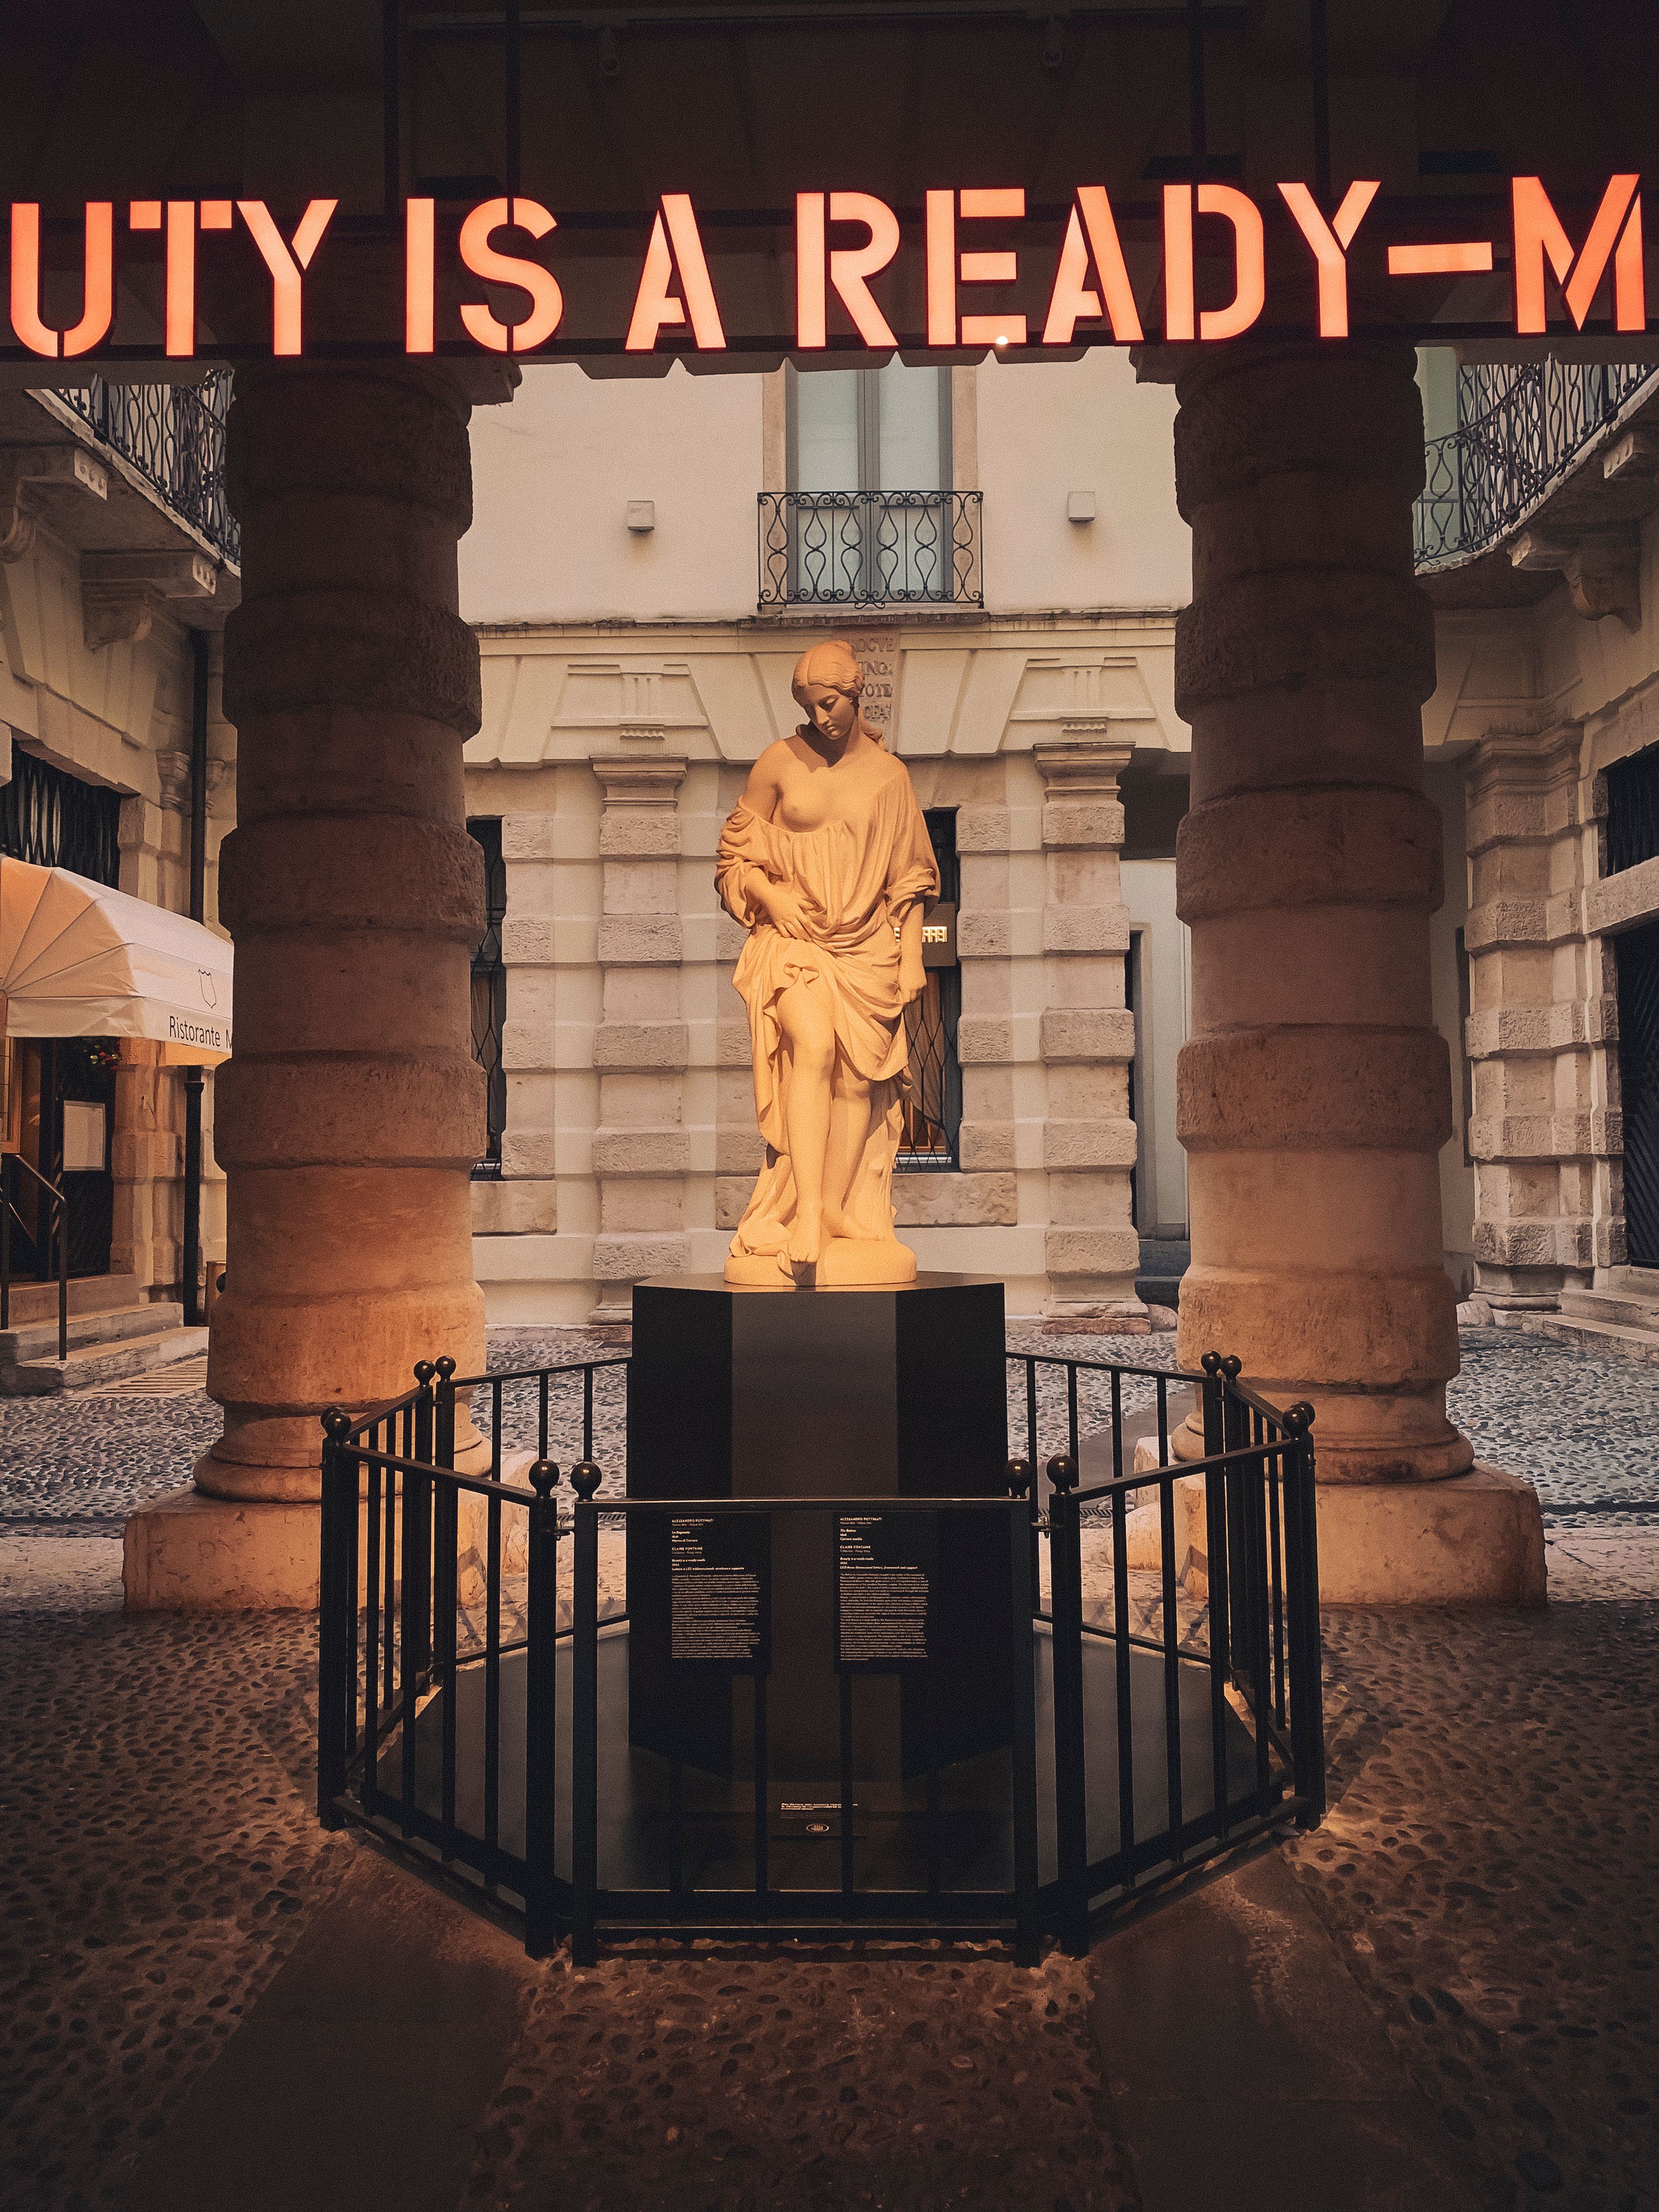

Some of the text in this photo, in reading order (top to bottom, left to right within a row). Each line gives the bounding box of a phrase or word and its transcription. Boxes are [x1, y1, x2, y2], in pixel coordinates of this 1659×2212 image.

[11, 199, 337, 358] UTY
[406, 197, 562, 353] IS
[625, 193, 727, 350] A
[169, 1015, 220, 1047] Ristorante
